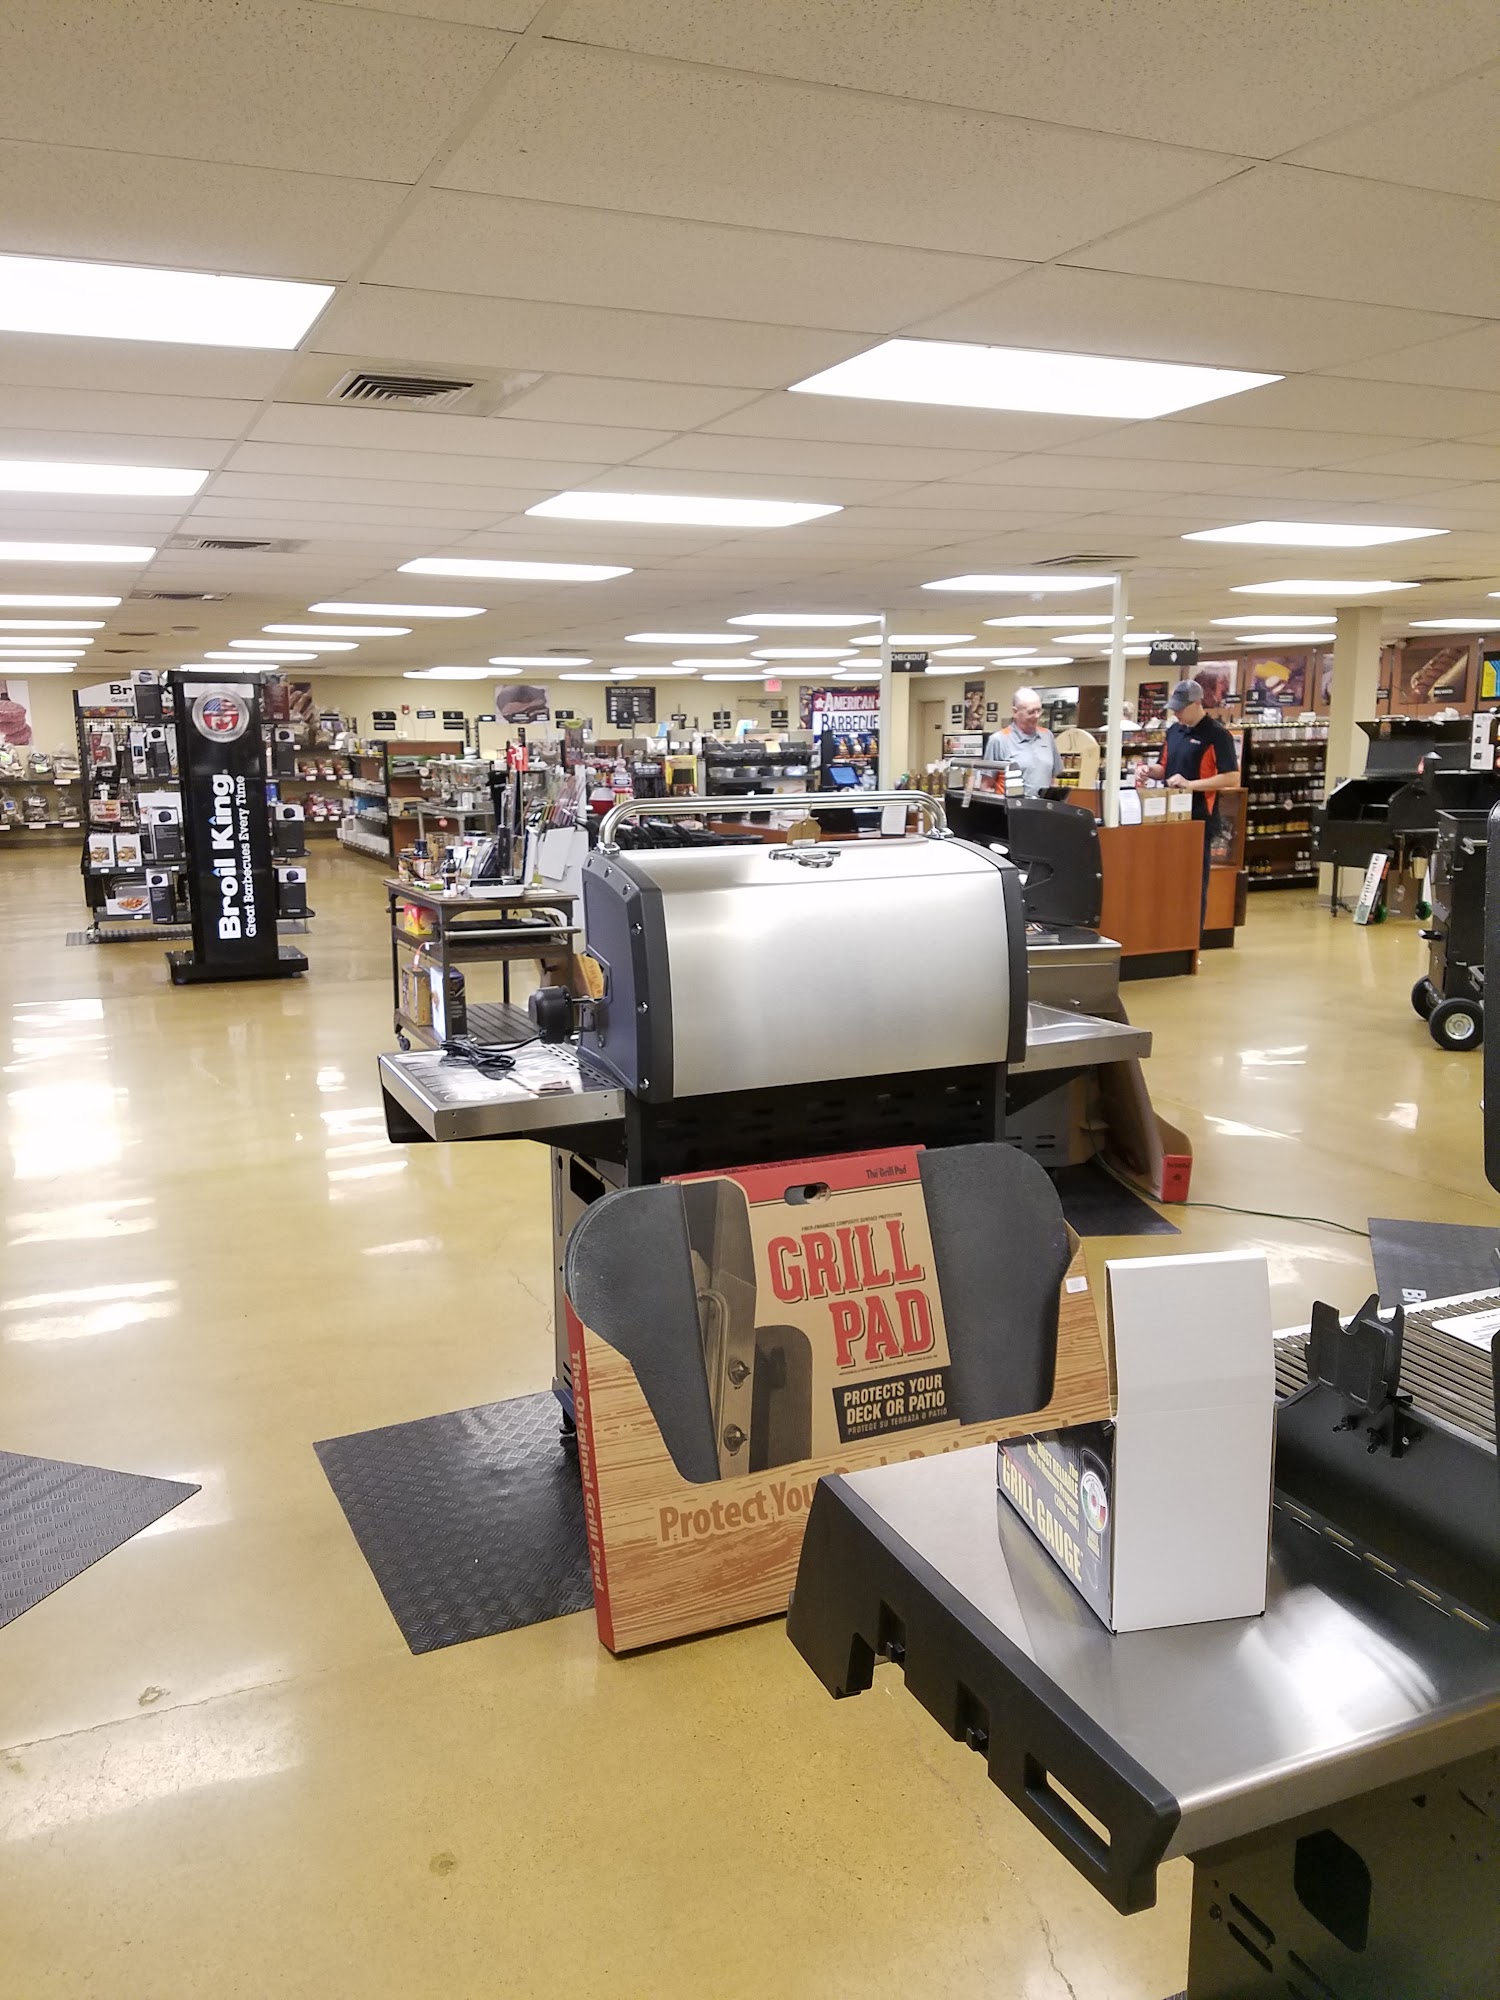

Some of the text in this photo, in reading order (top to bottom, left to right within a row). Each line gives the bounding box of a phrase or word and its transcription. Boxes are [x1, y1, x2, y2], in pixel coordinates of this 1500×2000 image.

[891, 653, 926, 661] CHECKOUT
[1152, 642, 1196, 651] CHECKOUT
[823, 692, 876, 711] AMERICAN
[208, 773, 242, 939] Broil King
[235, 775, 257, 937] Great Barbecues Every Time
[865, 1164, 907, 1179] The Grill Pad
[768, 1220, 926, 1303] GRILL
[828, 1289, 936, 1369] PAD
[844, 1374, 943, 1407] PROTECTS YOUR
[846, 1390, 945, 1425] DECK OR PATIO
[848, 1407, 948, 1434] PROTEGE SU TERRAZA O PATIO
[571, 1350, 605, 1592] The Original Grill Pad
[659, 1481, 818, 1541] Protect You
[1002, 1454, 1035, 1522] GRILL
[1037, 1498, 1082, 1583] GAUGE
